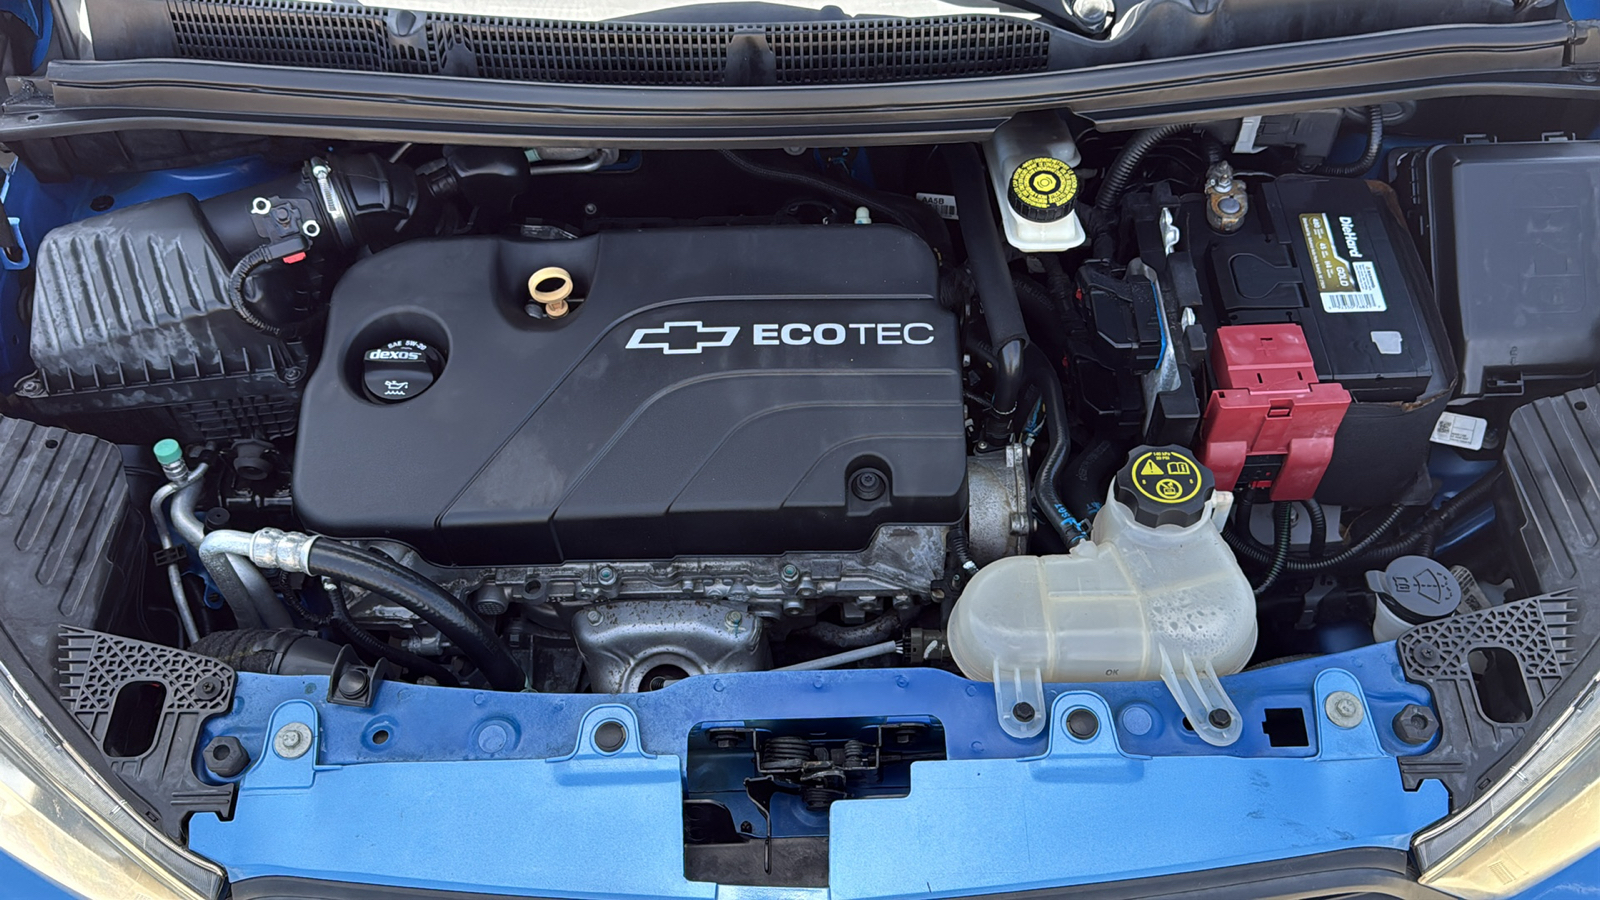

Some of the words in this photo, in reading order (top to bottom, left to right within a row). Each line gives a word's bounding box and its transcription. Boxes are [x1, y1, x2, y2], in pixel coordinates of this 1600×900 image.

[1339, 216, 1362, 257] DieHard
[1336, 266, 1349, 286] GOLD
[753, 323, 935, 346] ECOTEC
[369, 349, 422, 360] dexos
